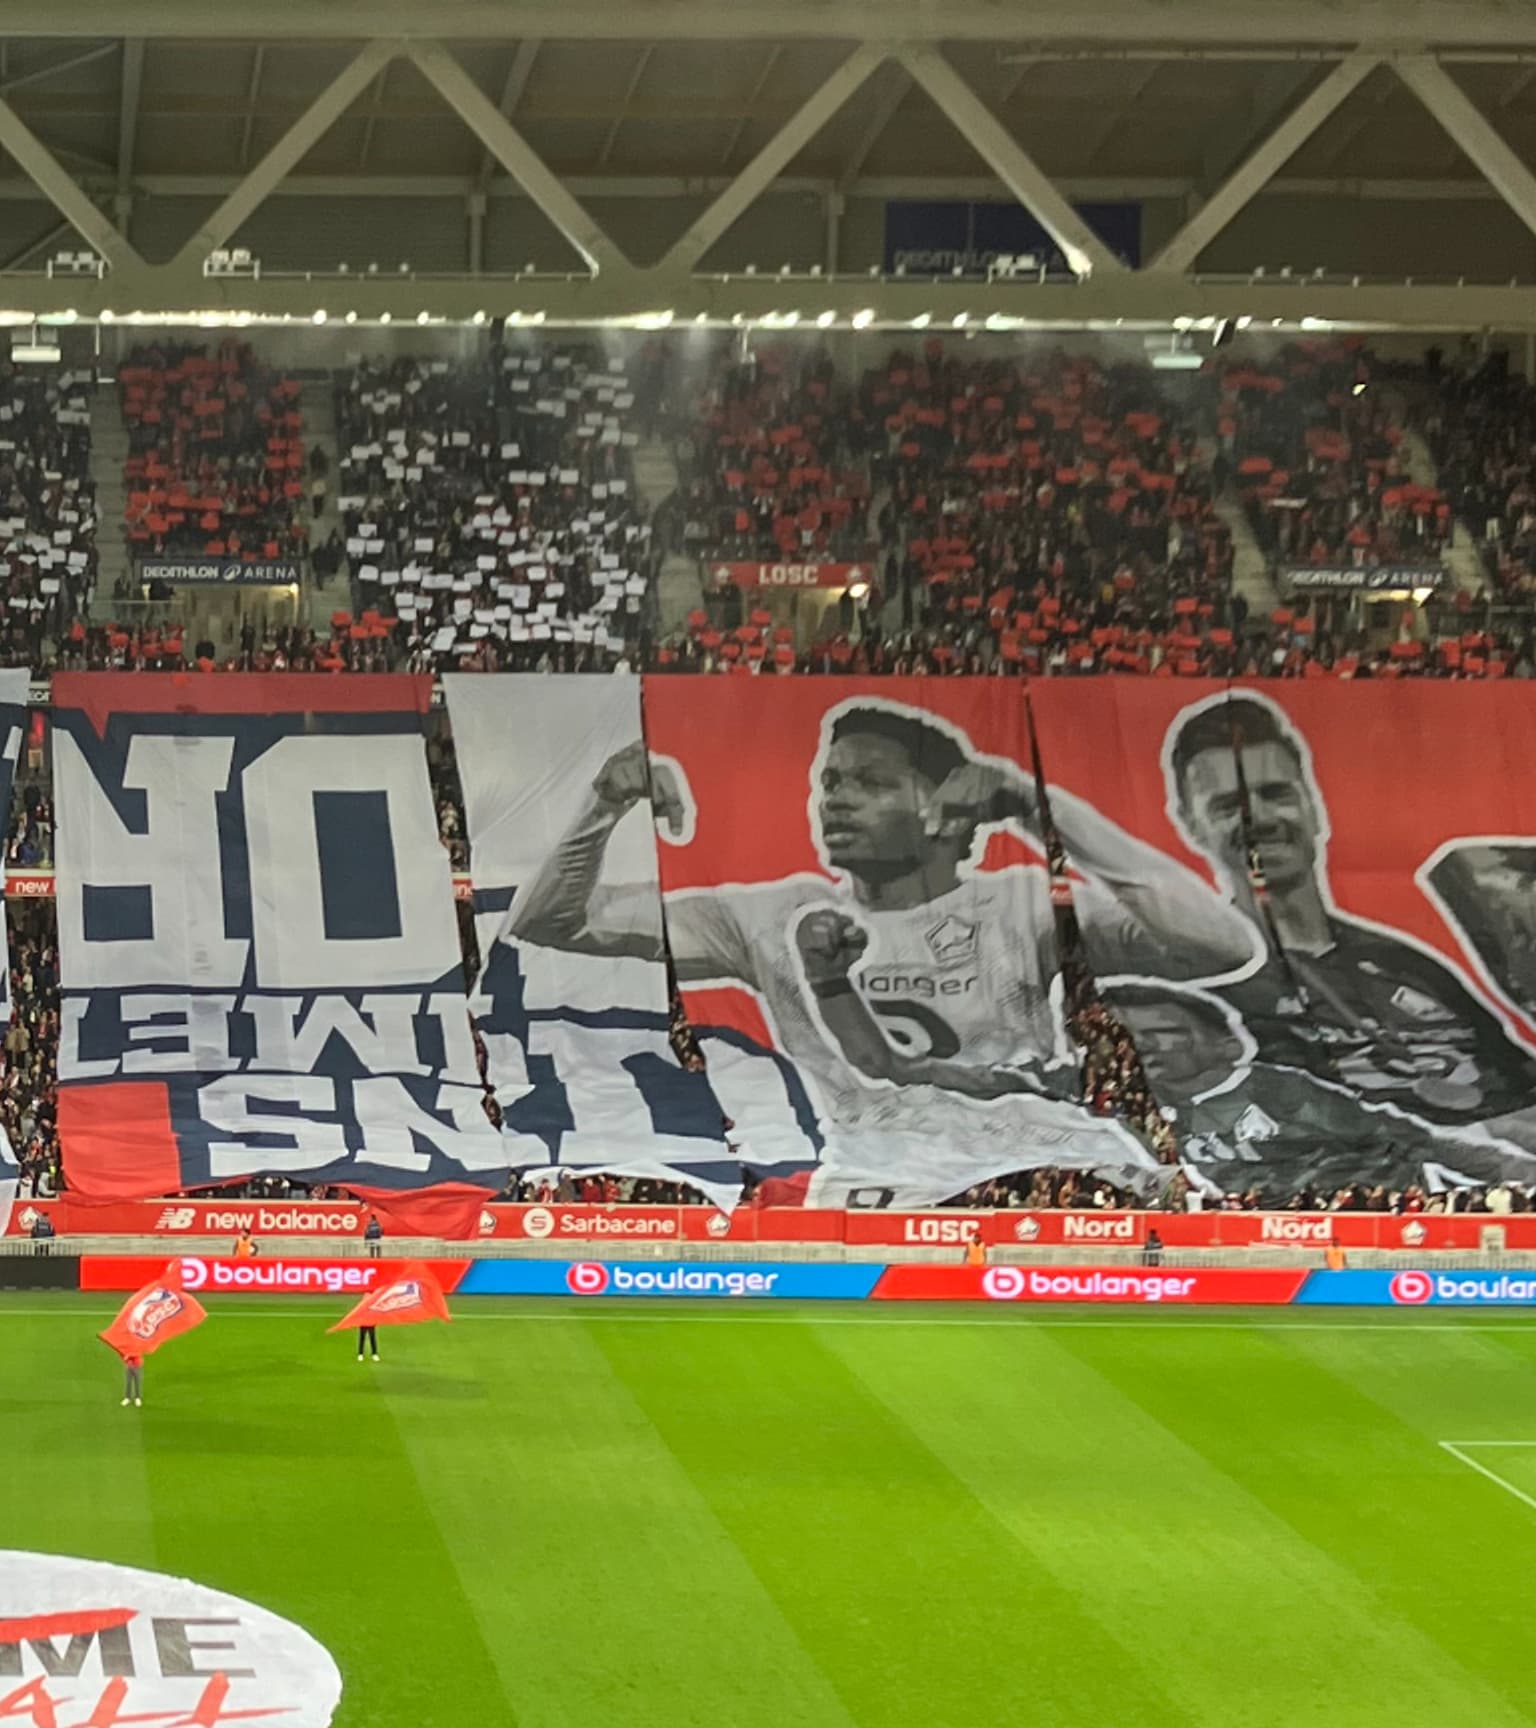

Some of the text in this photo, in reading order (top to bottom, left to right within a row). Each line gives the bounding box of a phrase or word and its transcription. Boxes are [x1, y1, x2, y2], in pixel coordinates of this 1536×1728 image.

[142, 565, 297, 579] DECATHLON ARENA
[759, 564, 818, 585] LOSC
[15, 881, 49, 894] new
[205, 1210, 252, 1229] new
[259, 1208, 358, 1230] balance
[560, 1213, 675, 1235] Sarbacane
[1064, 1216, 1134, 1238] Nord
[1261, 1217, 1333, 1240] Nord
[905, 1219, 979, 1243] LOSC
[214, 1262, 376, 1288] boulanger
[613, 1266, 779, 1295] boulanger
[1030, 1272, 1197, 1301] boulanger
